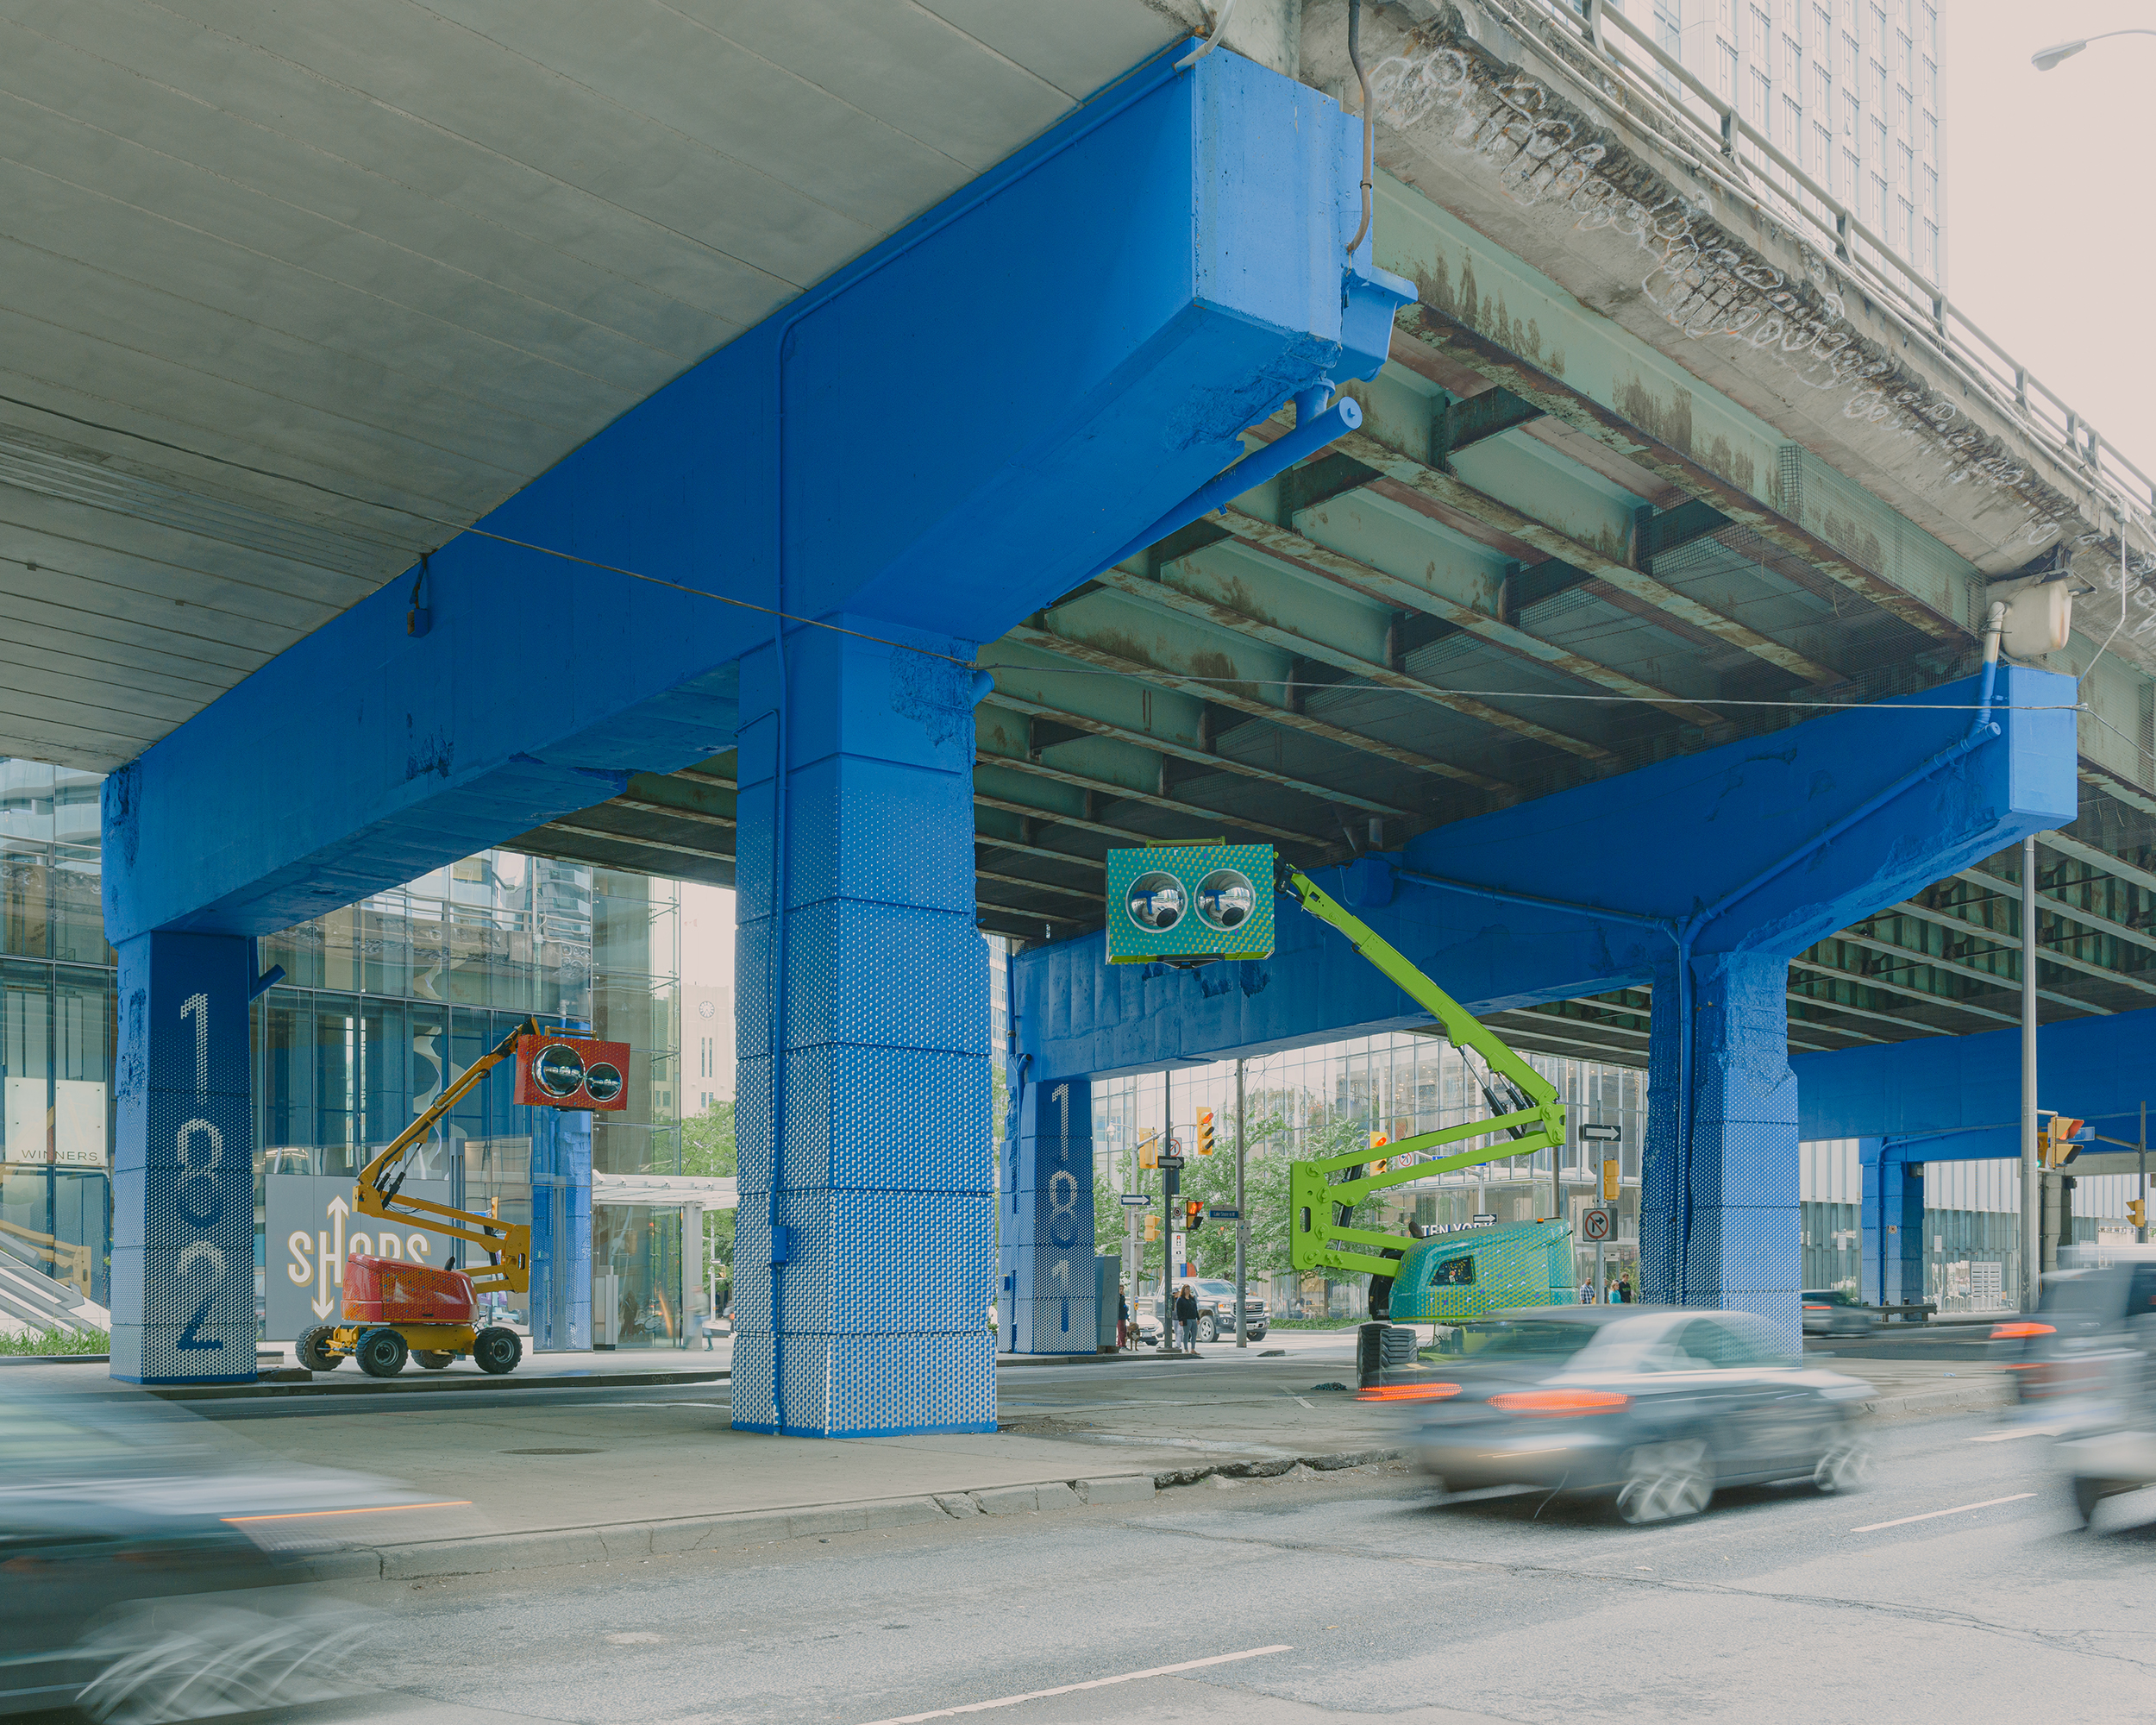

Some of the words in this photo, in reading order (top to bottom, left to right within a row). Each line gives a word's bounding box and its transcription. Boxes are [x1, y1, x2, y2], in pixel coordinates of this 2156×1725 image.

[178, 993, 229, 1351] 1802
[1049, 1082, 1080, 1334] 1801
[1421, 1225, 1451, 1236] TEN
